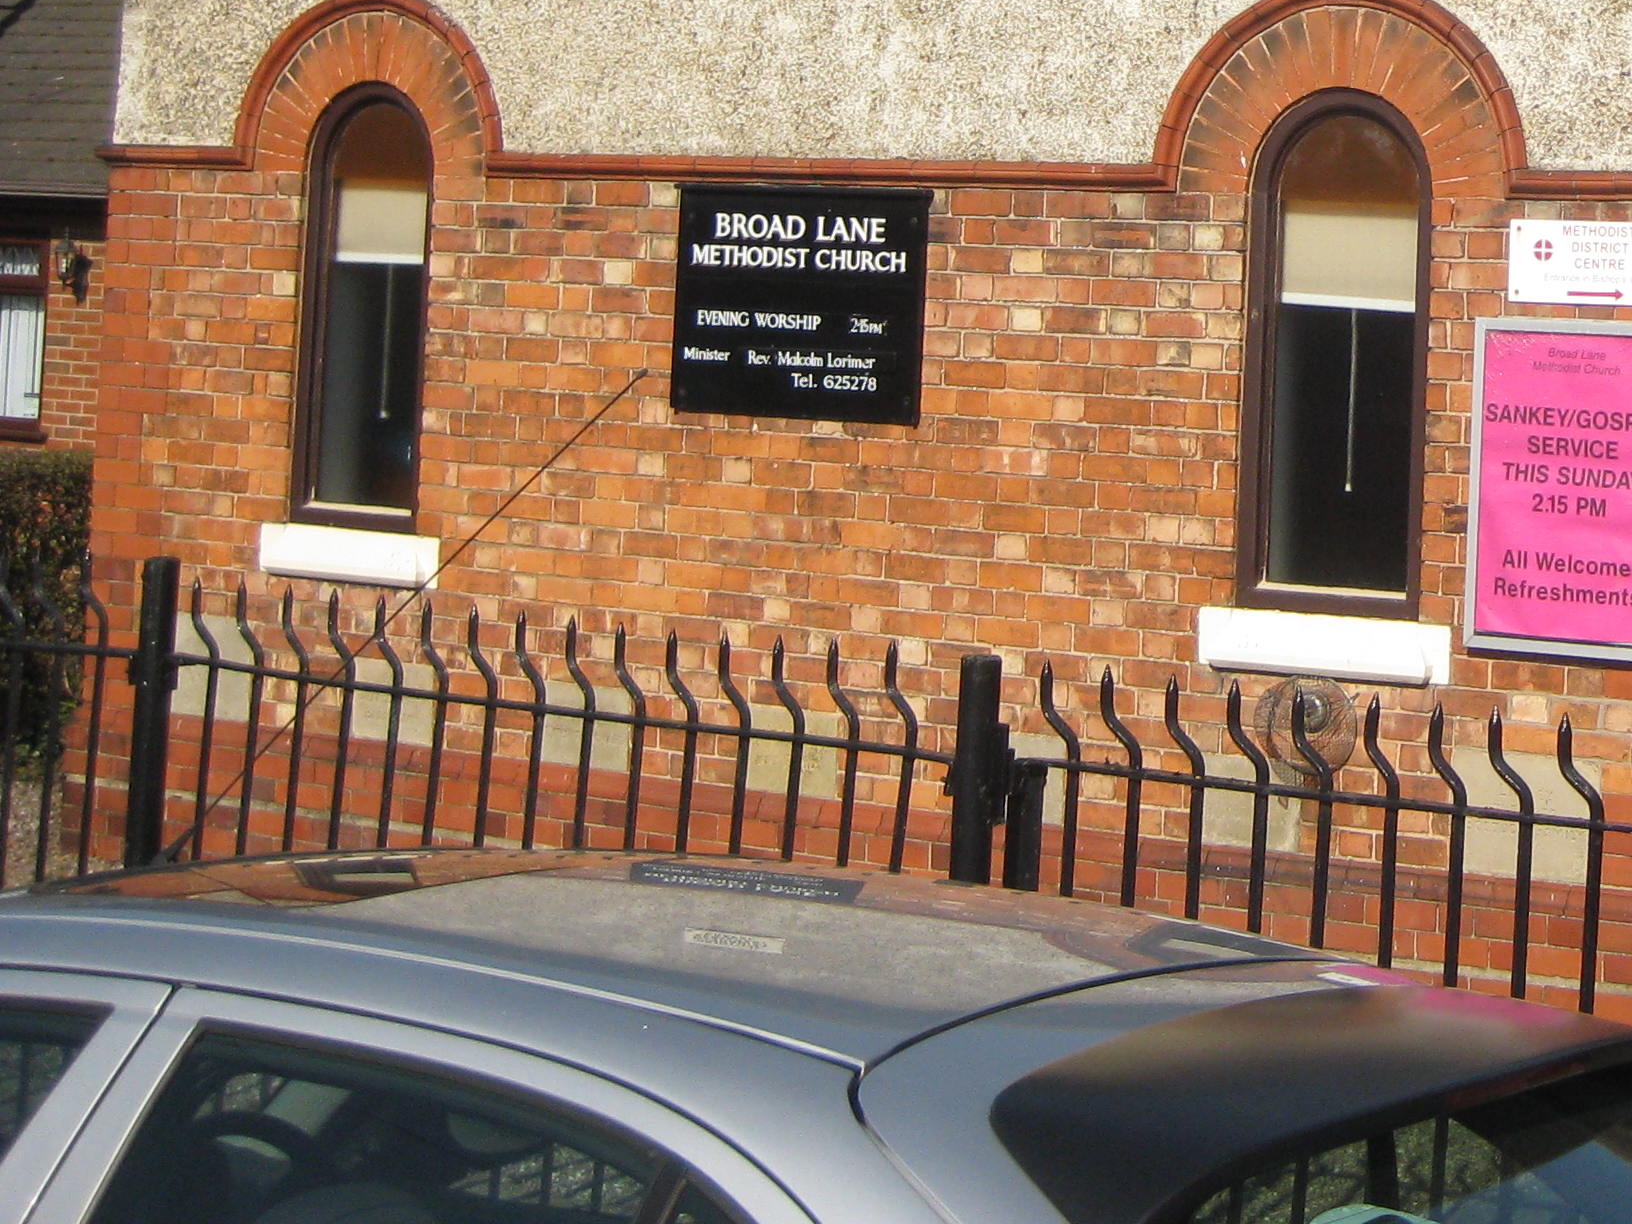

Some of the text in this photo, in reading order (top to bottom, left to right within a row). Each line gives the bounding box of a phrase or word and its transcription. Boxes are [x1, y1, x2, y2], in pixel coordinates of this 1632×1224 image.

[714, 212, 887, 243] BROAD LANE
[690, 244, 907, 273] METHODIST CHURCH
[1571, 242, 1630, 255] DISTRICT
[1574, 258, 1626, 271] CENTRE
[697, 309, 750, 327] EVENING
[754, 312, 822, 331] WORSHIP
[683, 346, 876, 370] Minister Rev. Malcolm Lorimer
[1548, 347, 1607, 361] Broad Lane
[1584, 363, 1622, 377] Church
[791, 373, 877, 392] Tel. 625278
[1527, 435, 1620, 460] SERVICE
[1502, 461, 1549, 484] THIS
[1531, 493, 1607, 517] 2.15 PM
[1502, 549, 1632, 577] All Welcome
